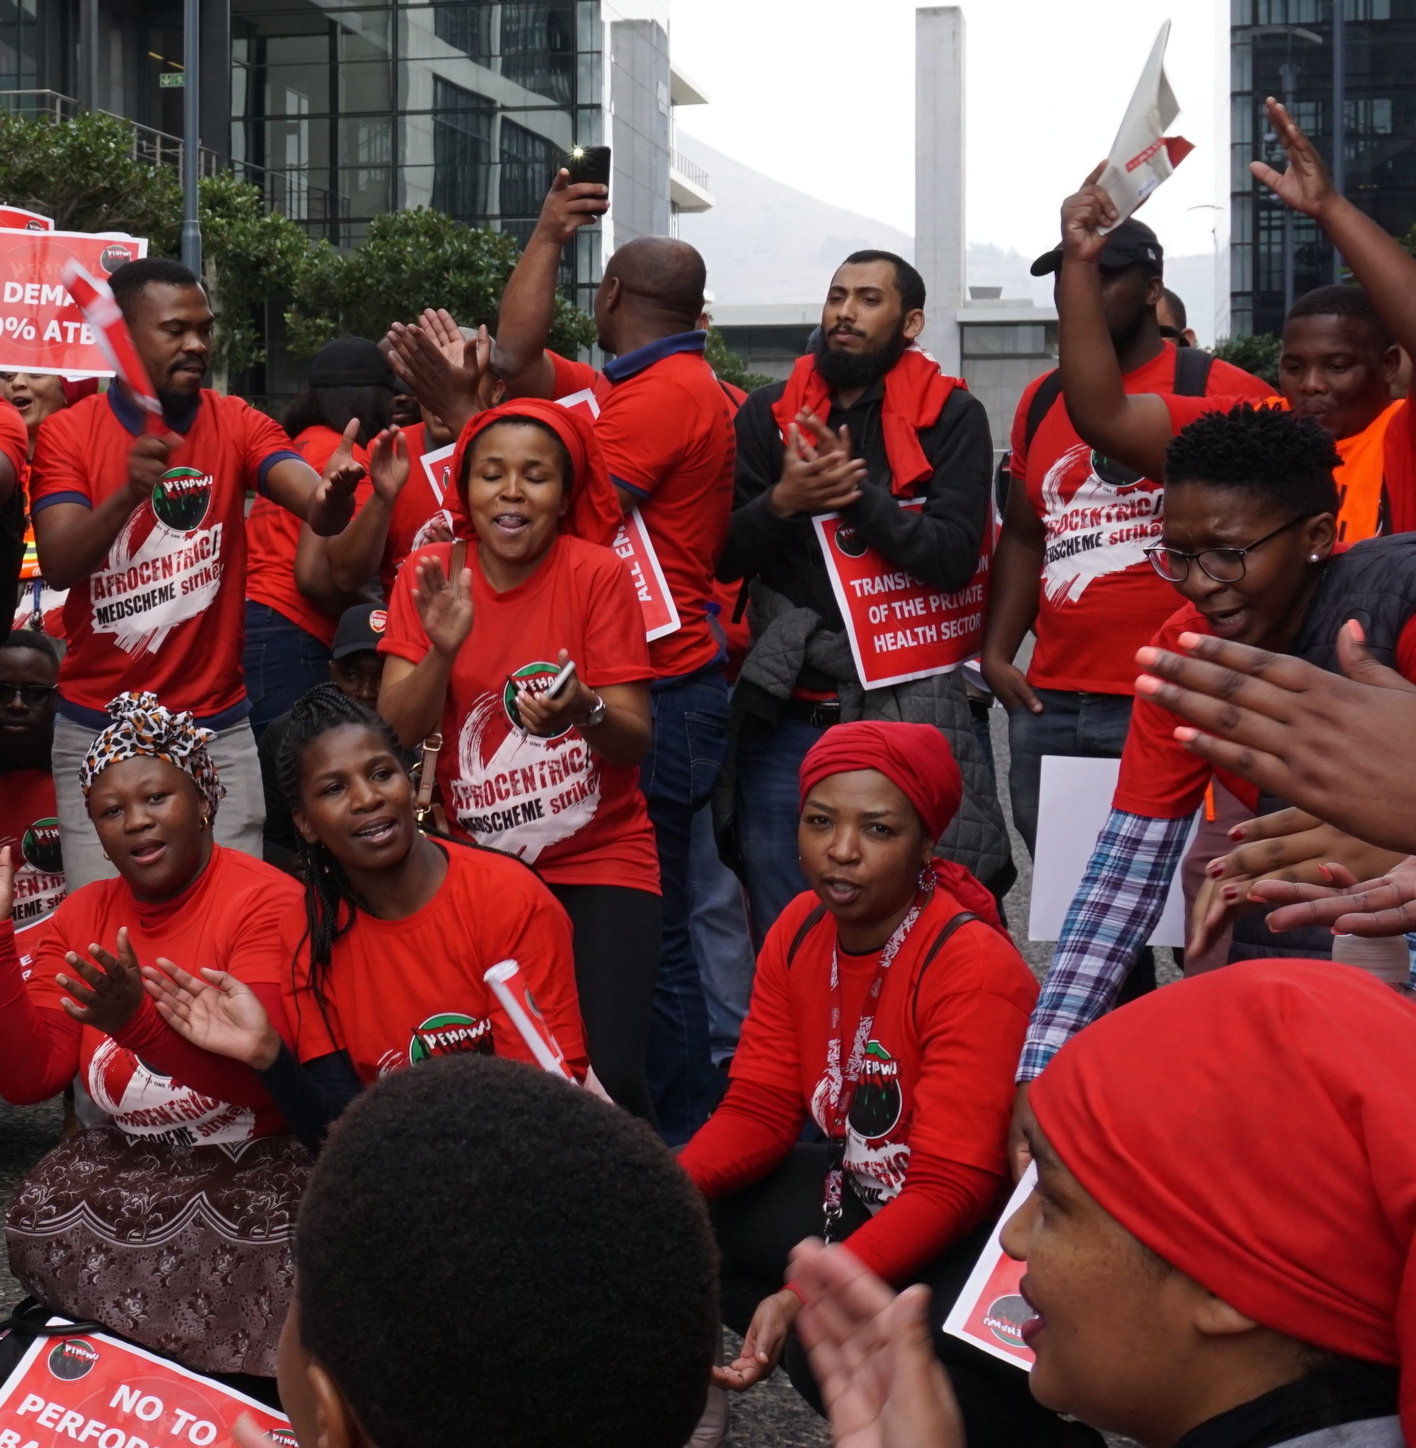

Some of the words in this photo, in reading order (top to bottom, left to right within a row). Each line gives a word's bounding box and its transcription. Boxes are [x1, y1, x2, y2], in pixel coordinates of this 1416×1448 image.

[4, 282, 80, 308] DEMA
[631, 561, 652, 601] ALL
[96, 582, 177, 625] MEDSCHEME
[868, 604, 888, 624] OF
[892, 598, 926, 618] THE
[929, 584, 983, 613] PRIVATE
[873, 625, 938, 653] HEALTH
[941, 613, 982, 640] SECTOR
[515, 676, 557, 691] NEHA
[983, 1317, 1022, 1338] EHAWU
[17, 1393, 159, 1448] PERFOR
[110, 1384, 164, 1423] NO
[174, 1408, 217, 1446] TO
